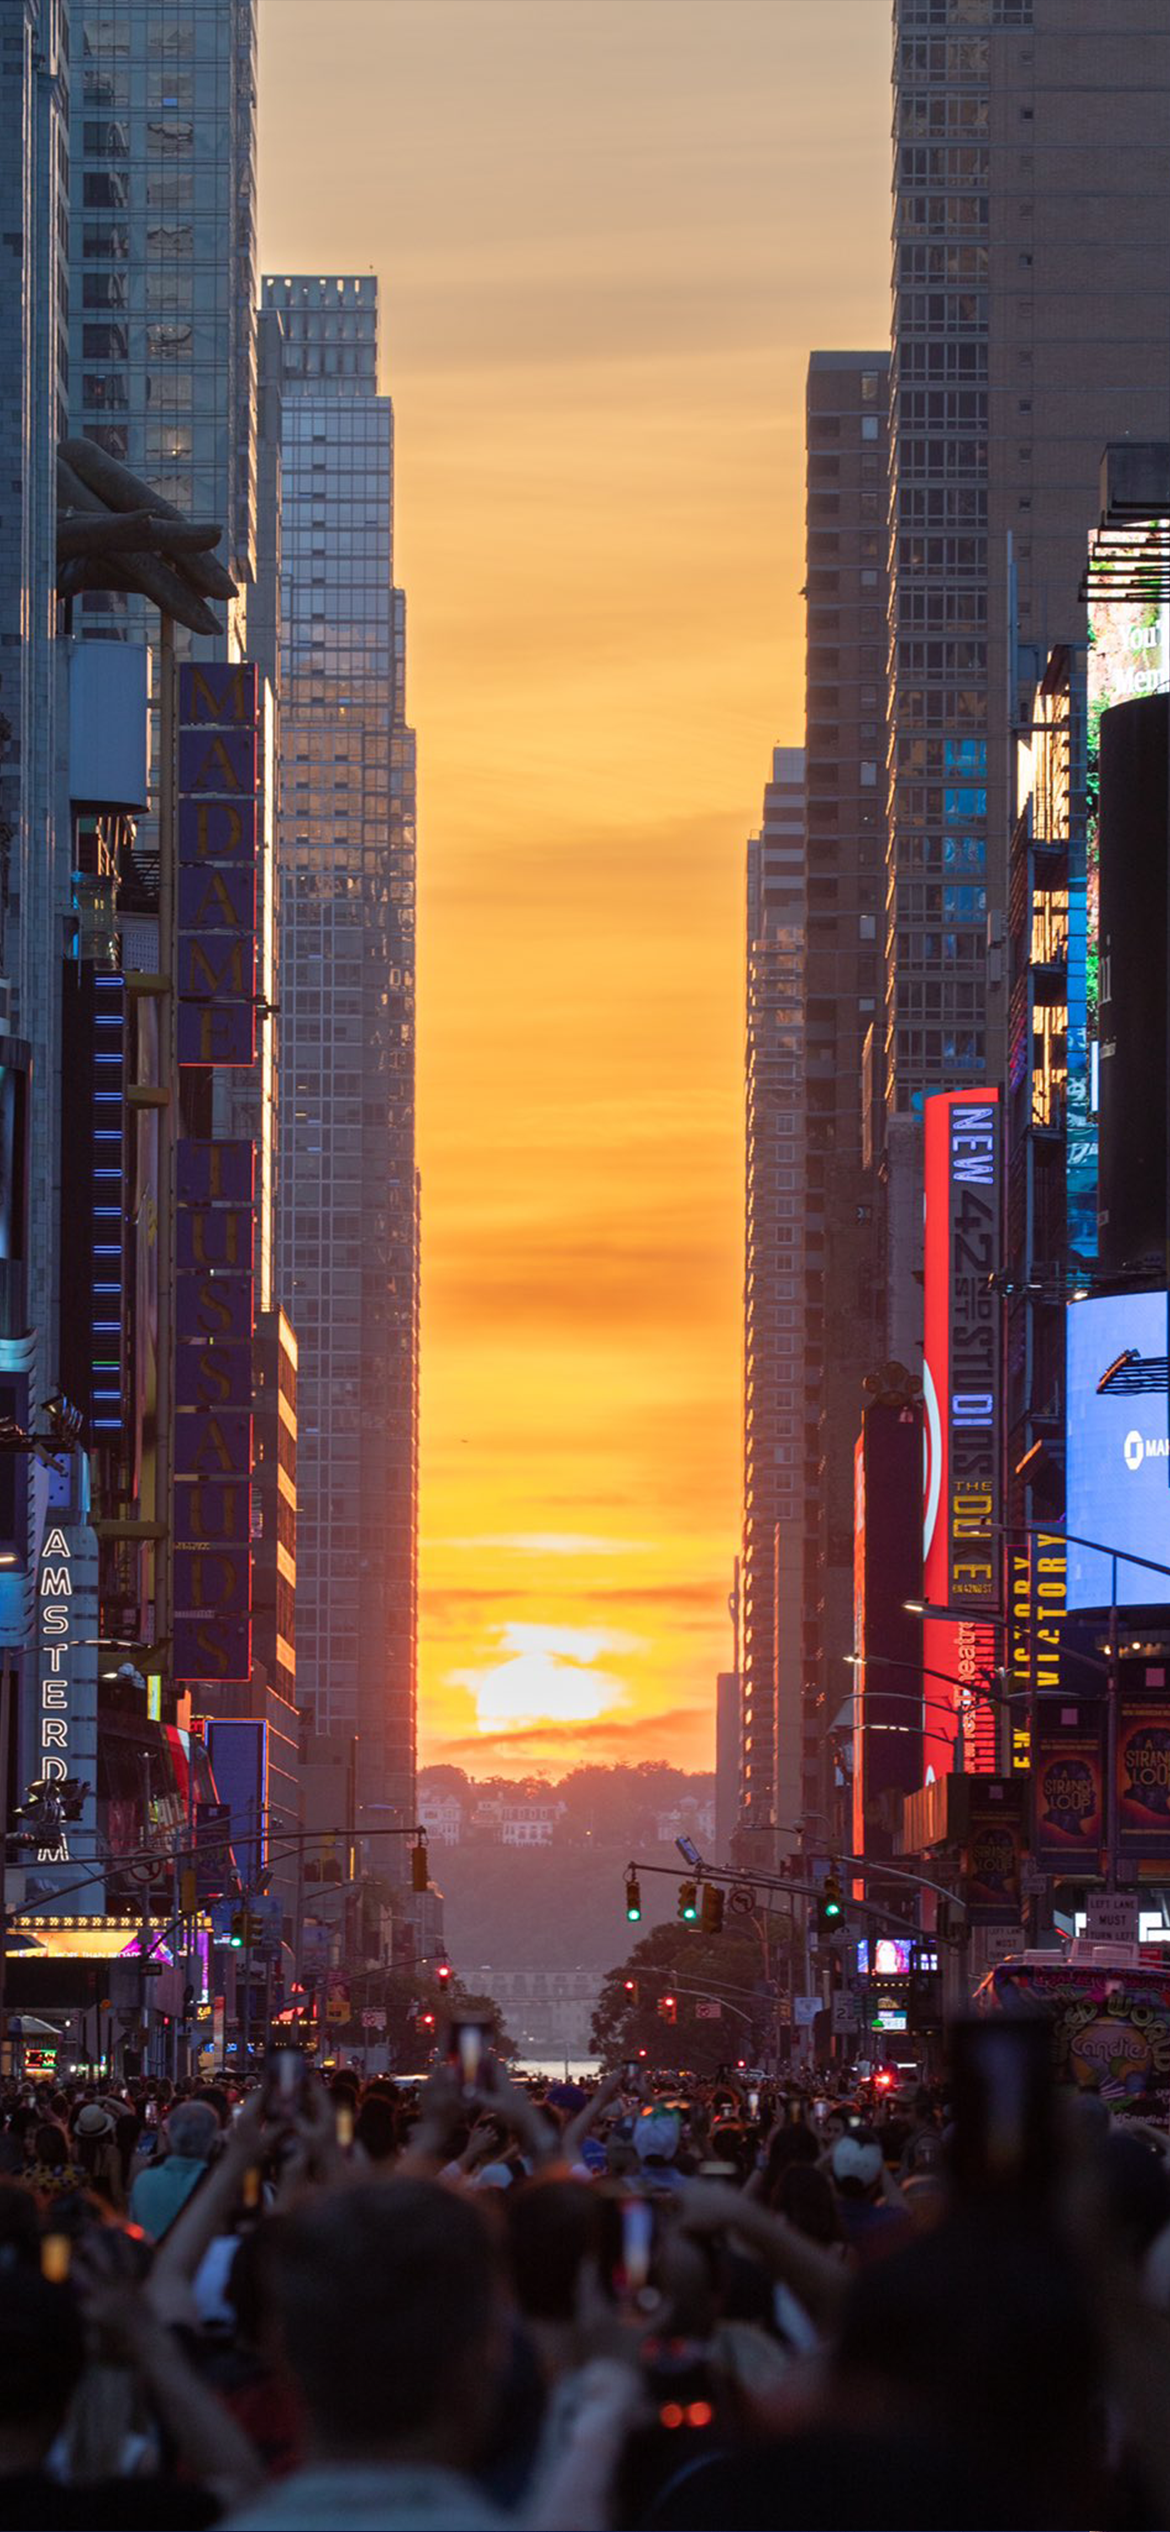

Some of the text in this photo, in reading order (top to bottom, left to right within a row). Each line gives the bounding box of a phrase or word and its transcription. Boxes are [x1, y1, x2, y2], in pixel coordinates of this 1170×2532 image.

[187, 666, 248, 1061] MADAME
[952, 1107, 993, 1184] NEW
[189, 1142, 242, 1674] TUSSAUDS
[952, 1326, 993, 1475] STUDIOS
[953, 1481, 992, 1491] THE
[952, 1494, 992, 1579] DUKE
[1037, 1533, 1067, 1687] VICTORY
[38, 1528, 72, 1862] AMSTERDM
[1013, 1727, 1031, 1769] EW
[1145, 1739, 1153, 1750] A
[1061, 1769, 1068, 1779] A
[1090, 1900, 1135, 1909] LEFT LANE
[1099, 1915, 1126, 1926] MUST
[1091, 1931, 1135, 1940] TURN LEFT
[1070, 2035, 1152, 2063] Candies
